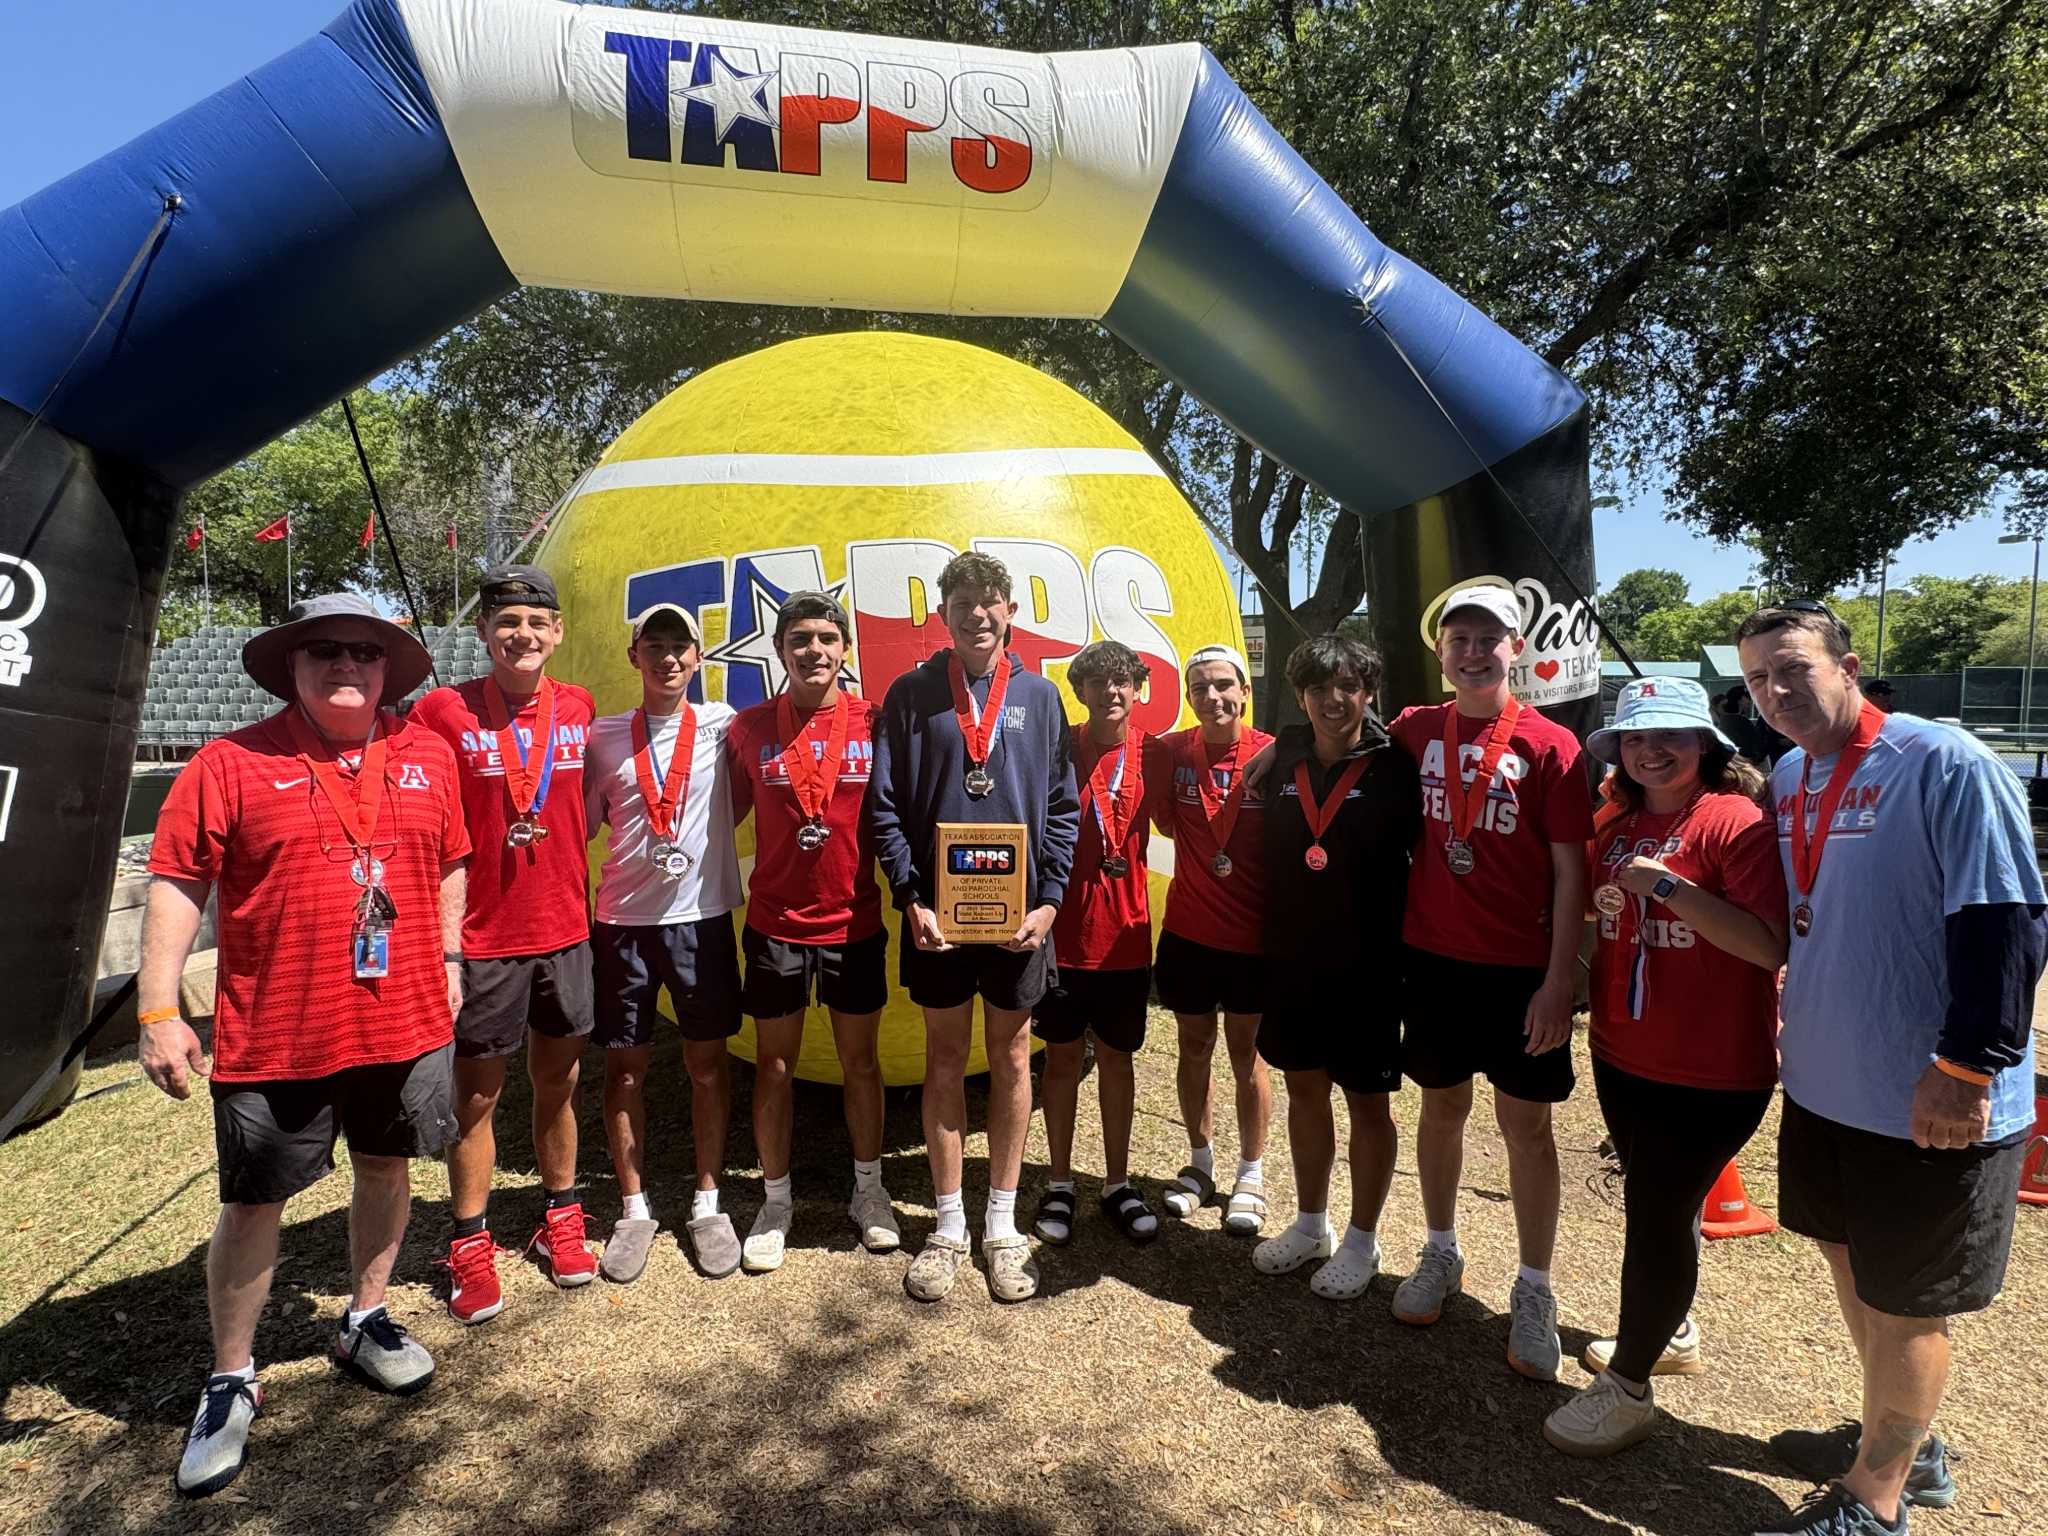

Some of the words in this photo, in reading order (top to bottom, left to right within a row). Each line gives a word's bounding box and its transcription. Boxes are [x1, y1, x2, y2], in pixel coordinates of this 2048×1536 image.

[604, 31, 1033, 193] TAPPS
[1563, 652, 1597, 679] TEXAS
[1543, 683, 1577, 699] VISITORS
[464, 746, 586, 767] TEIS
[400, 765, 430, 789] A
[759, 760, 873, 778] TEIS
[1421, 785, 1520, 835] TEIS
[953, 849, 1009, 869] TAPPS
